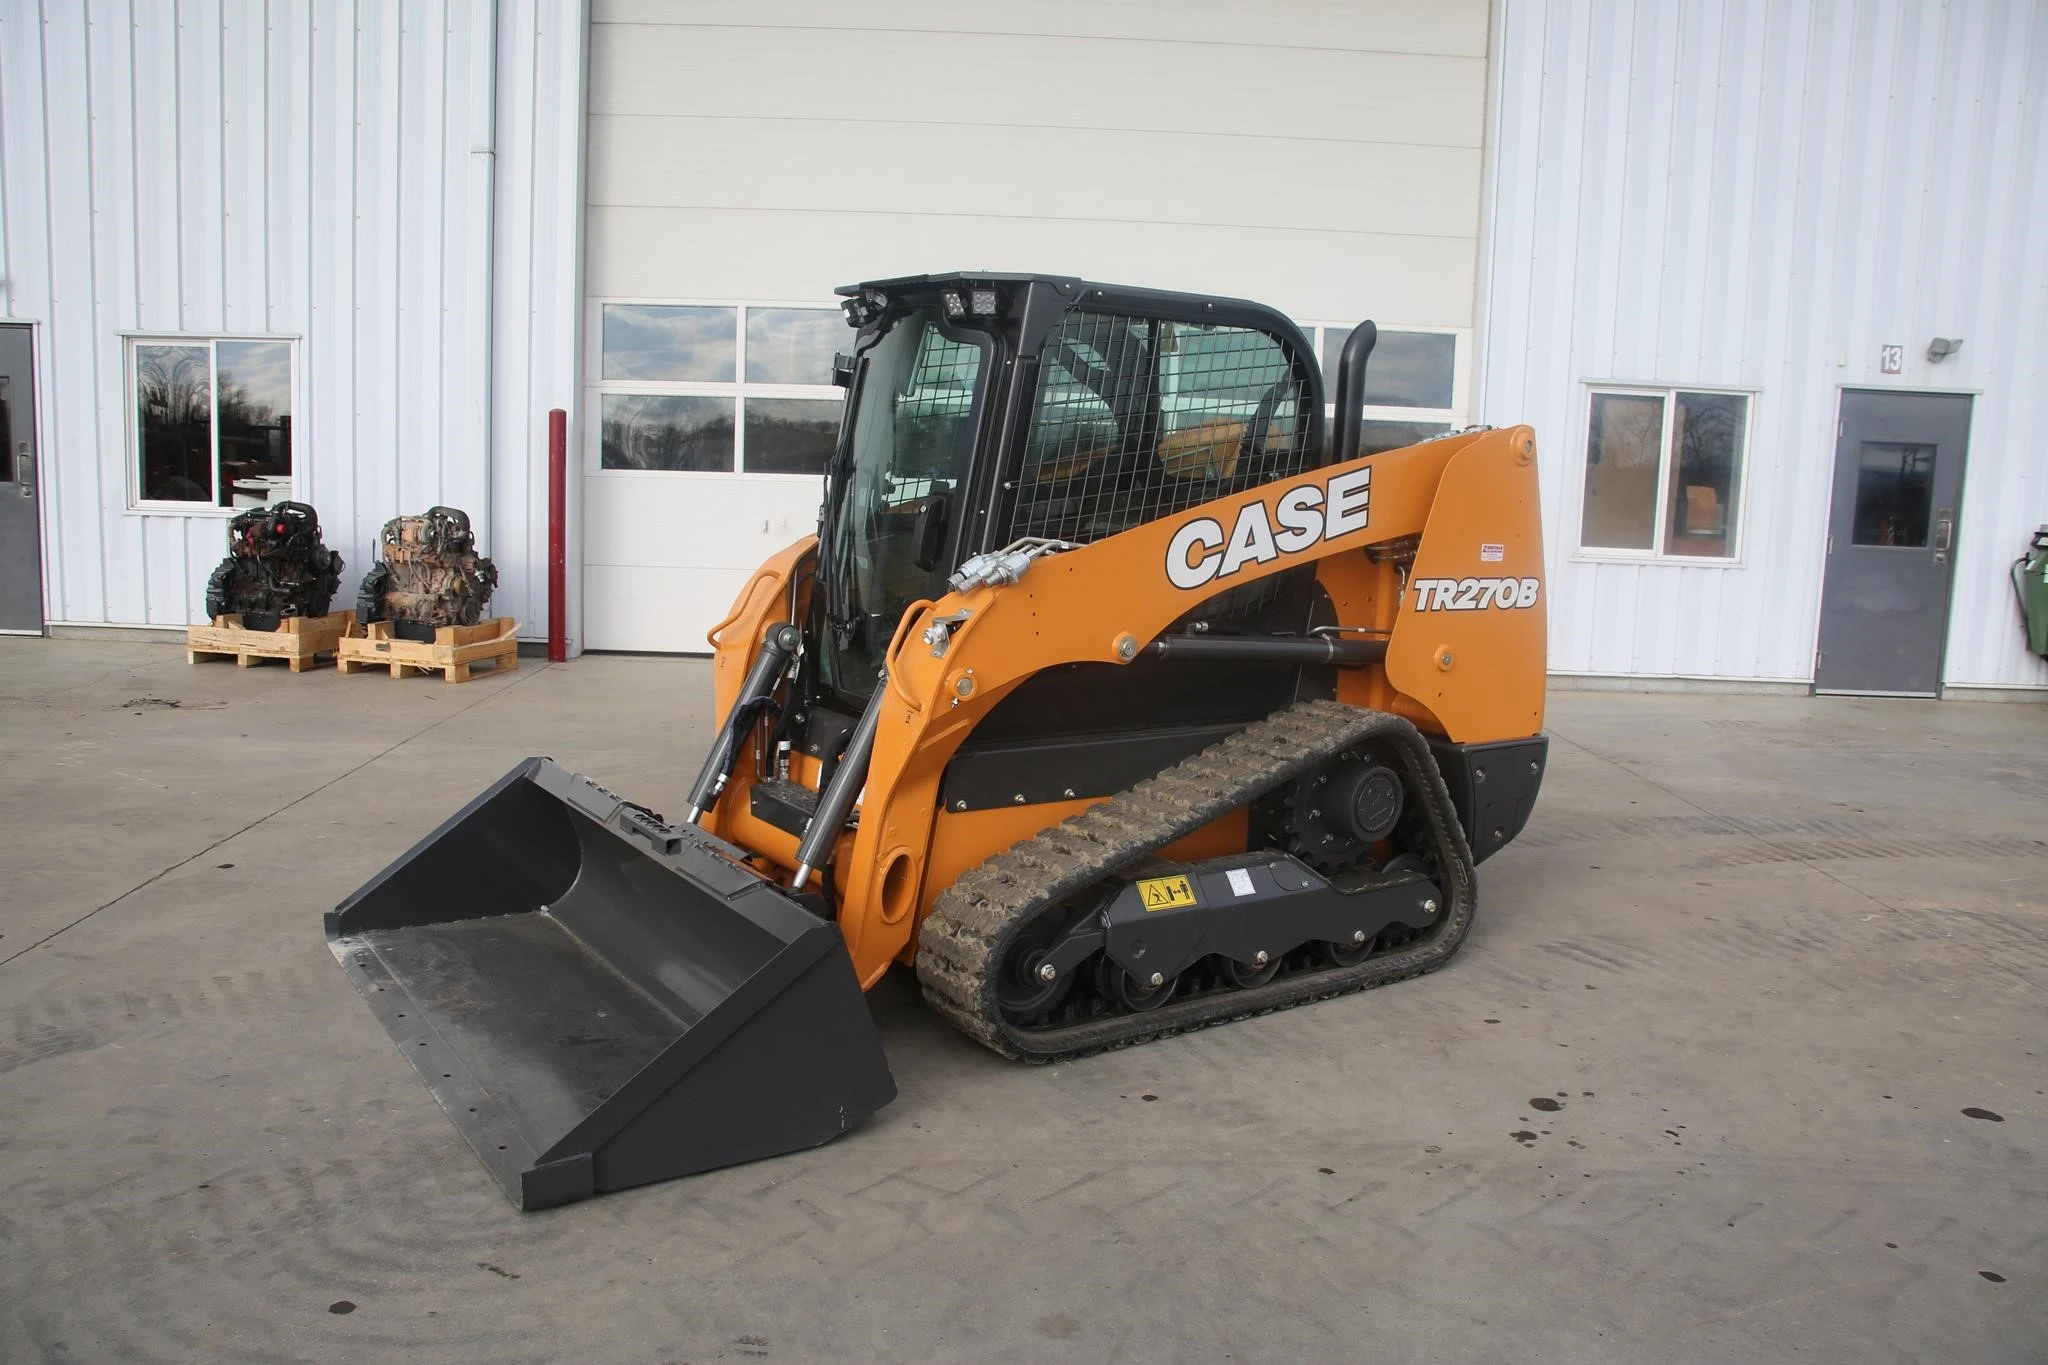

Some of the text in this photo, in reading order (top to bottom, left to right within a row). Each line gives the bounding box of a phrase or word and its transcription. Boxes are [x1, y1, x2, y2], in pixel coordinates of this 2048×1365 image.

[1882, 346, 1902, 370] 13
[1165, 465, 1372, 590] CASE
[1414, 576, 1539, 612] TR270B
